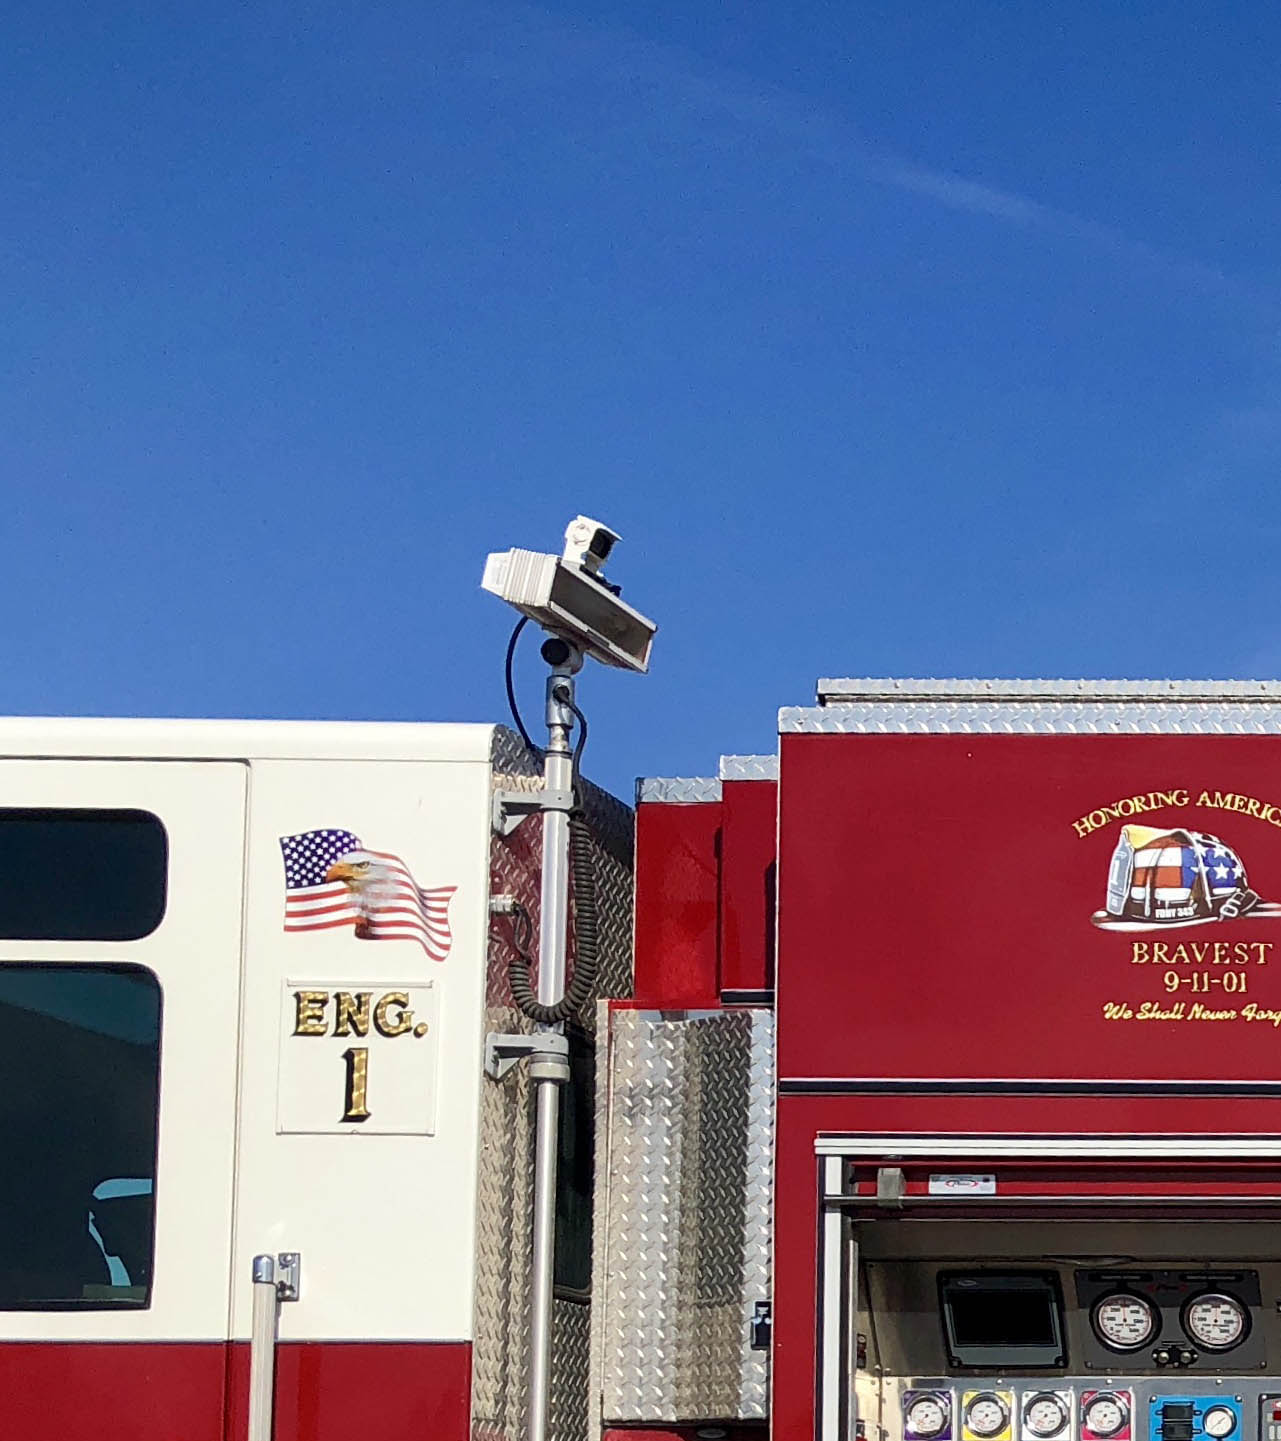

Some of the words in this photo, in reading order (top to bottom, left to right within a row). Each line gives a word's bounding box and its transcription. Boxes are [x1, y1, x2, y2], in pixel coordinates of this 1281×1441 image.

[1071, 789, 1190, 838] HONORING
[1130, 942, 1273, 964] BRAVEST
[1163, 971, 1248, 993] 9-11-01
[291, 990, 428, 1038] ENG.
[1103, 1002, 1134, 1020] We
[1135, 1002, 1184, 1020] Shall
[1186, 1003, 1237, 1021] Never
[337, 1047, 372, 1123] 1
